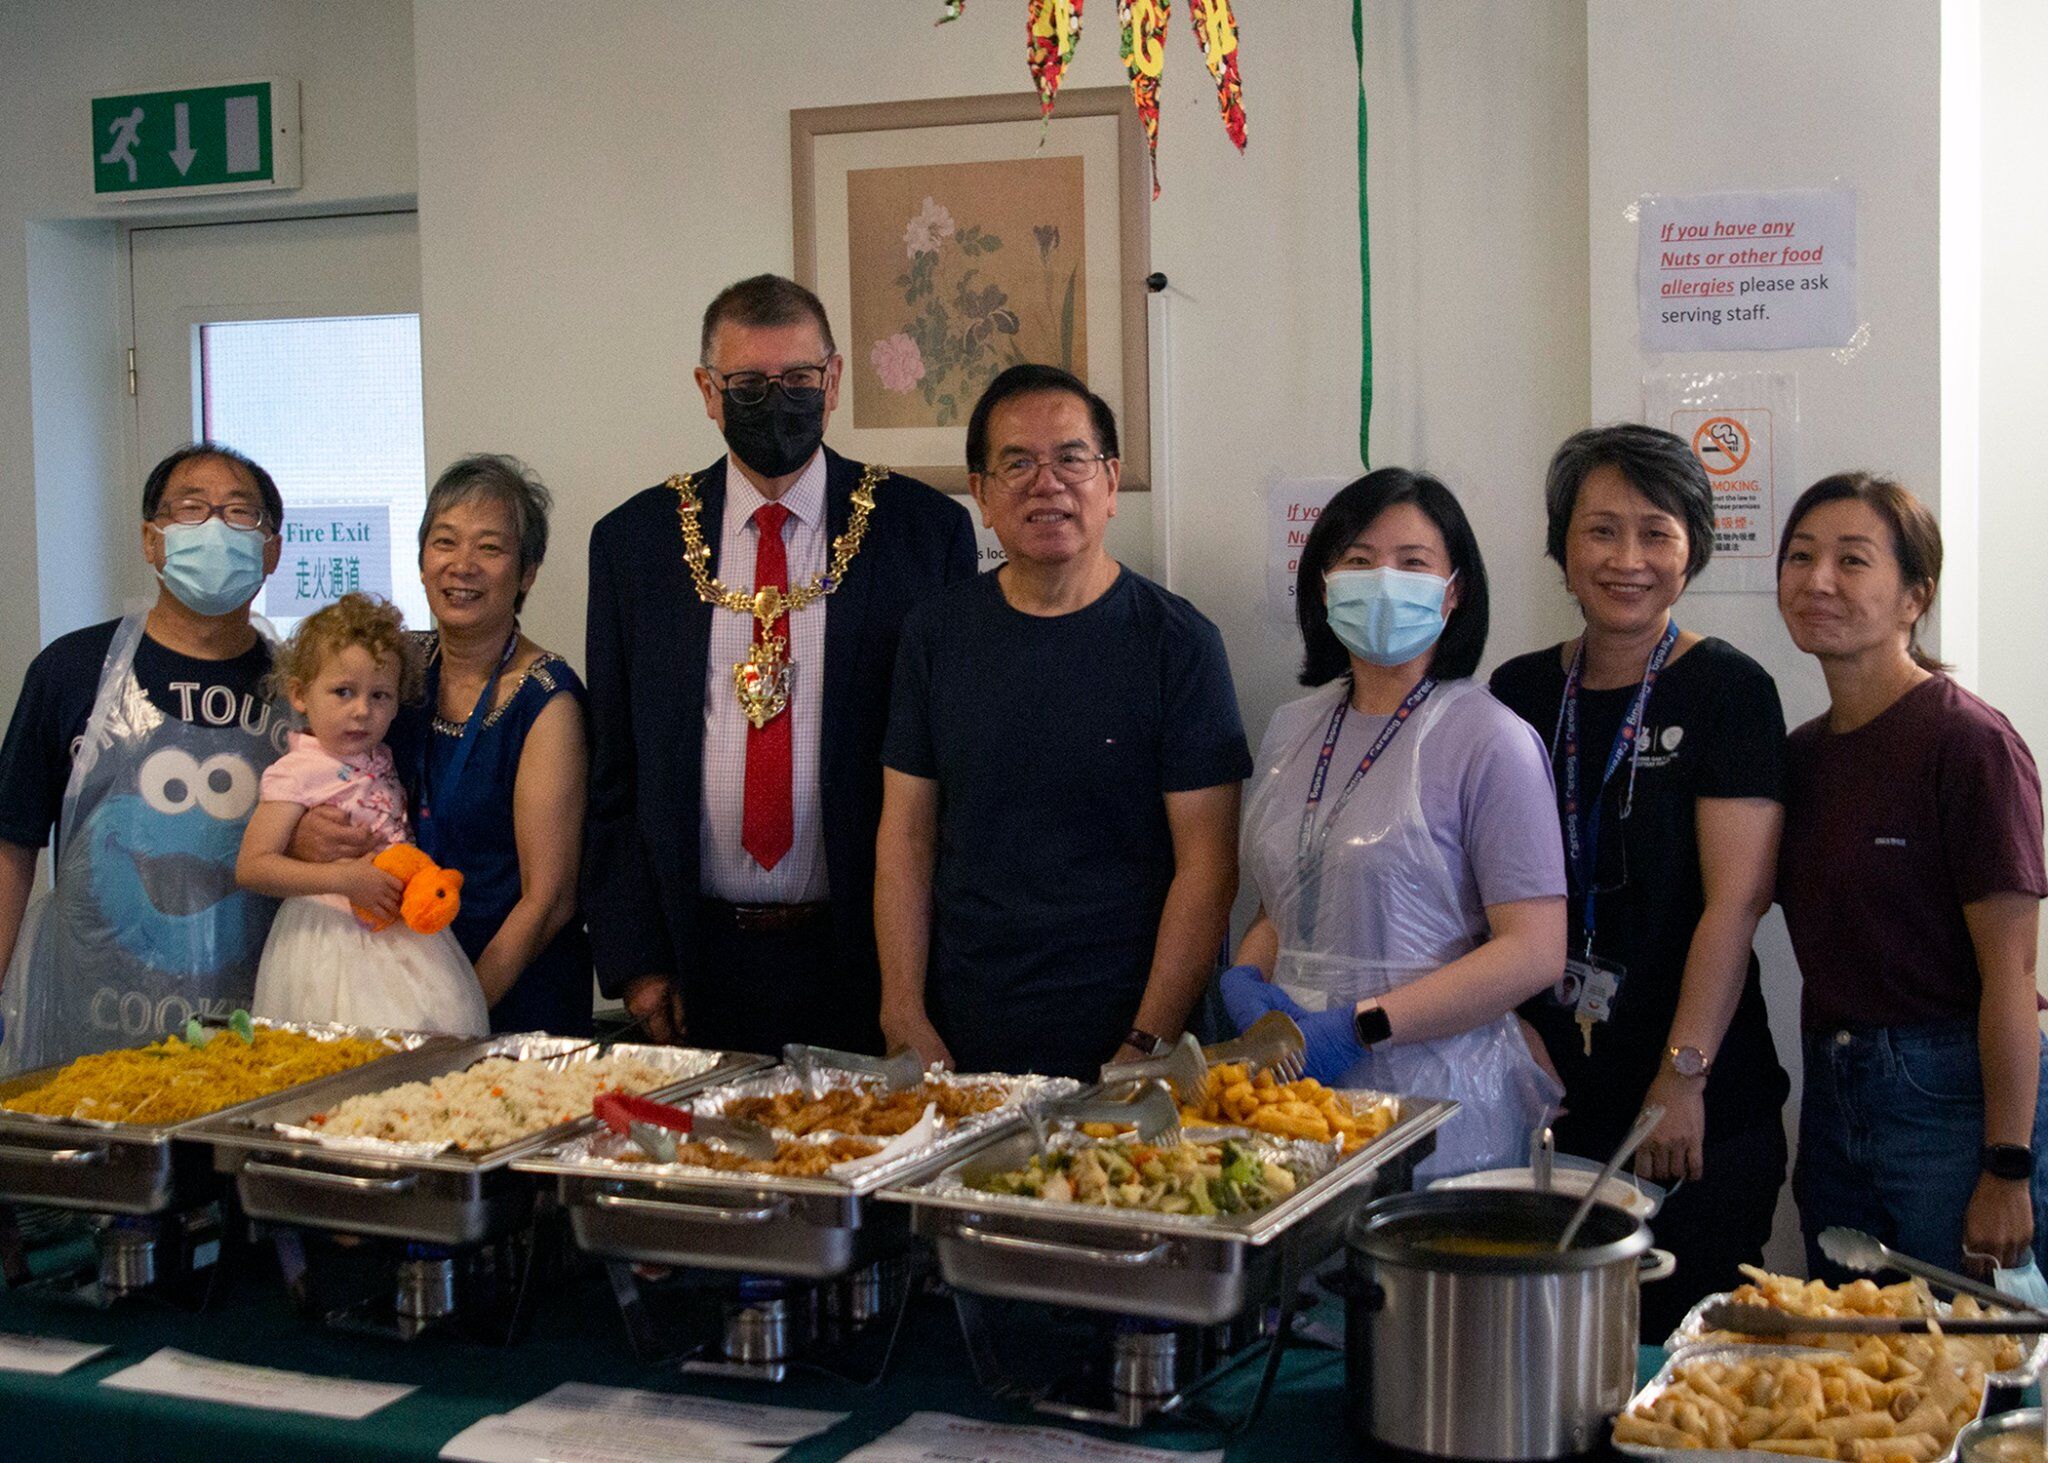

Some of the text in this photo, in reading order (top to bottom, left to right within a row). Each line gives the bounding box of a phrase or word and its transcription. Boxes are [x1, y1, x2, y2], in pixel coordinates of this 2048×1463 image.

[1661, 221, 1796, 242] If you have any
[1660, 245, 1824, 269] Nuts or other food
[1660, 274, 1829, 298] allergies please ask
[1661, 304, 1770, 325] serving staff.
[1711, 480, 1761, 492] MOKING.
[1287, 504, 1324, 521] If yo
[286, 522, 370, 543] Fire Exit
[1287, 530, 1310, 547] Nu
[295, 556, 360, 600] 走火通道
[1369, 718, 1401, 758] Caredig
[1406, 679, 1435, 707] Cared
[1565, 698, 1577, 741] Caredig
[1565, 755, 1577, 799] Caredig
[1567, 813, 1578, 860] Caredig
